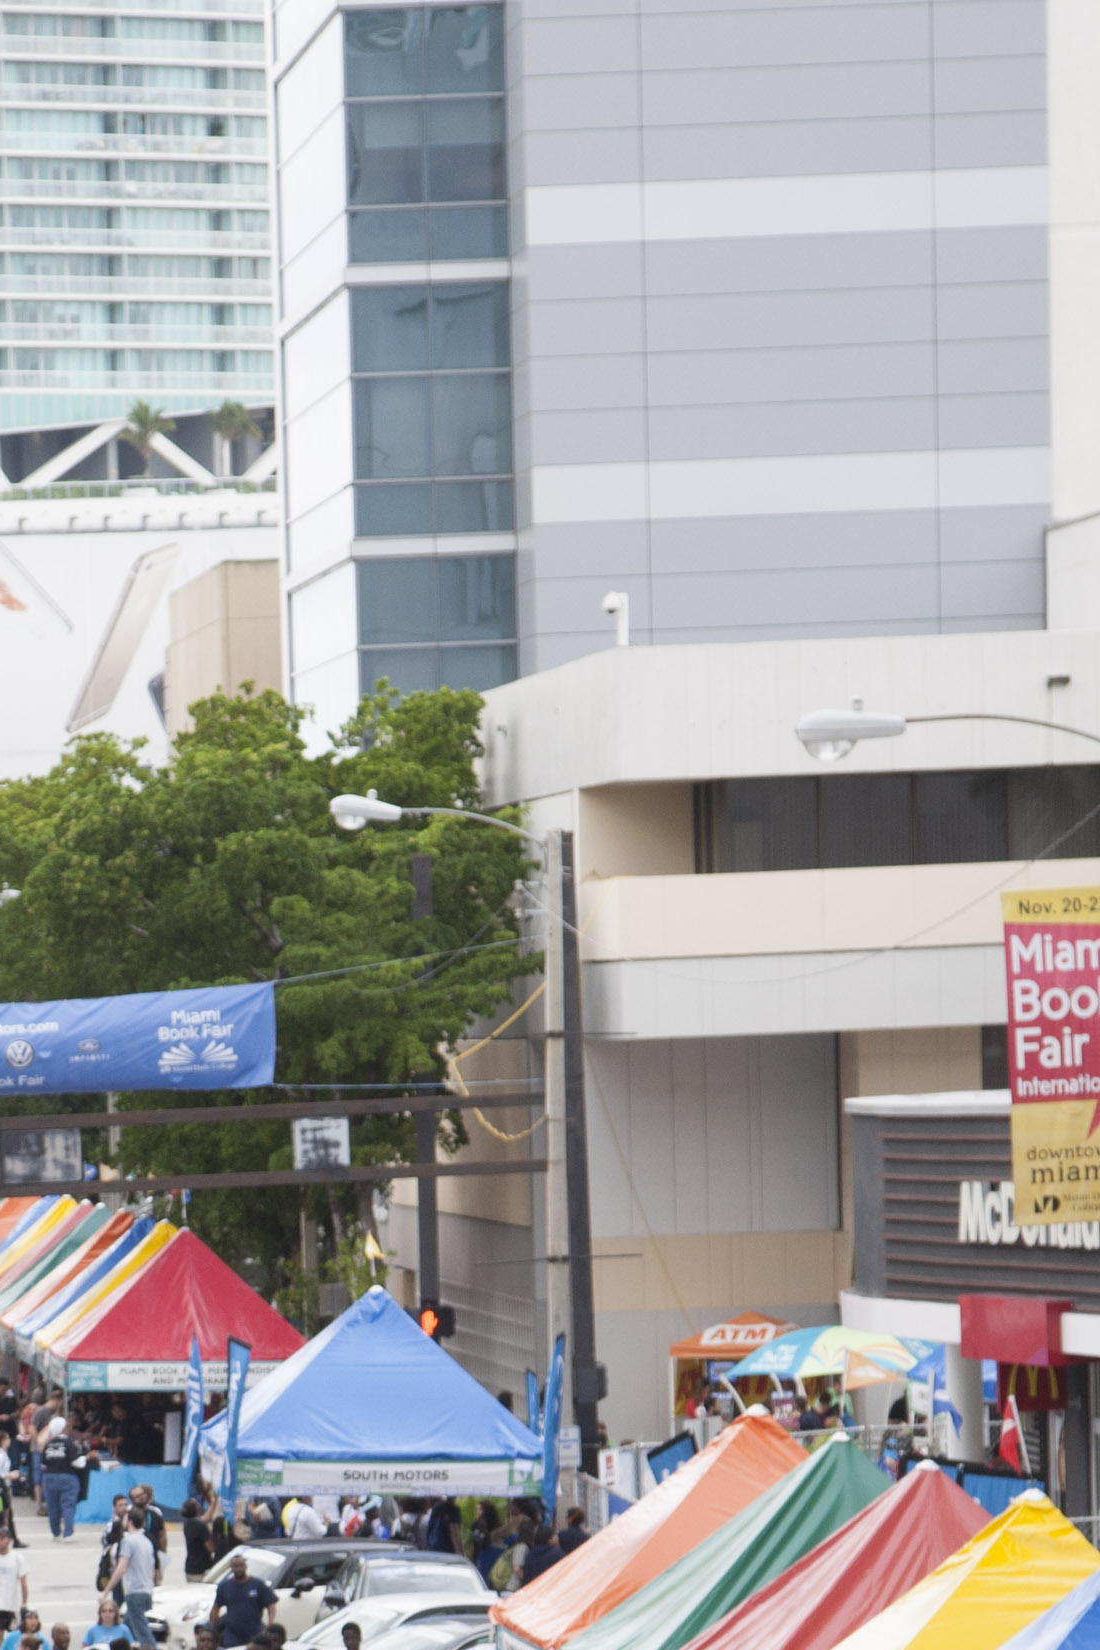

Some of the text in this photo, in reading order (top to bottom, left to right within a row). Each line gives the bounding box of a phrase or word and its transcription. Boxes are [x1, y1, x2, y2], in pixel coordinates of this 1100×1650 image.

[1019, 896, 1100, 914] Nov. 20-2
[1013, 976, 1100, 1022] Boo
[171, 1009, 220, 1025] Miami
[158, 1024, 235, 1041] Book Fair
[1015, 1026, 1090, 1070] Fair
[18, 1072, 45, 1087] Fair
[709, 1327, 770, 1342] ATM
[343, 1469, 449, 1481] SOUTH MOTORS
